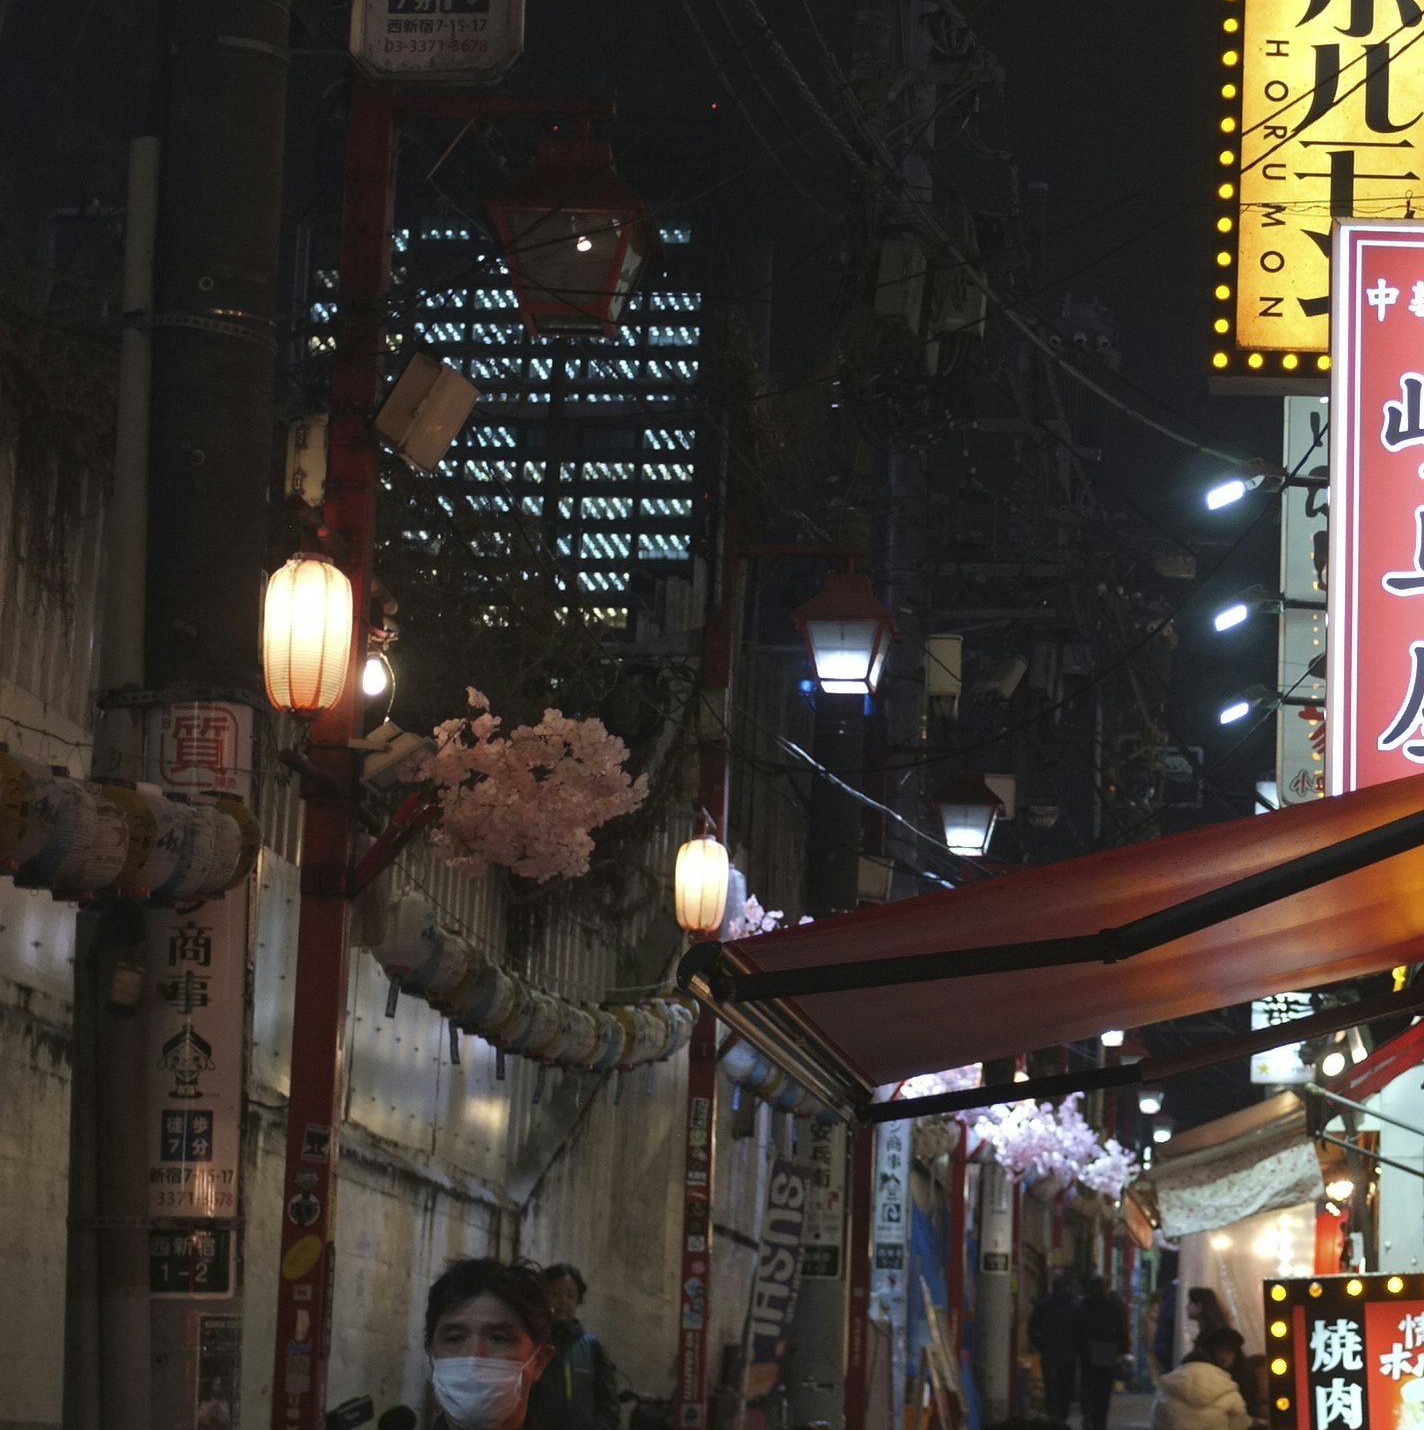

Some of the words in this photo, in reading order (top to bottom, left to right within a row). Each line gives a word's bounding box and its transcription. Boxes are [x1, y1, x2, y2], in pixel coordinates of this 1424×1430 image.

[1258, 38, 1289, 319] HORUMON
[171, 716, 230, 776] 質
[168, 1138, 208, 1157] 7分
